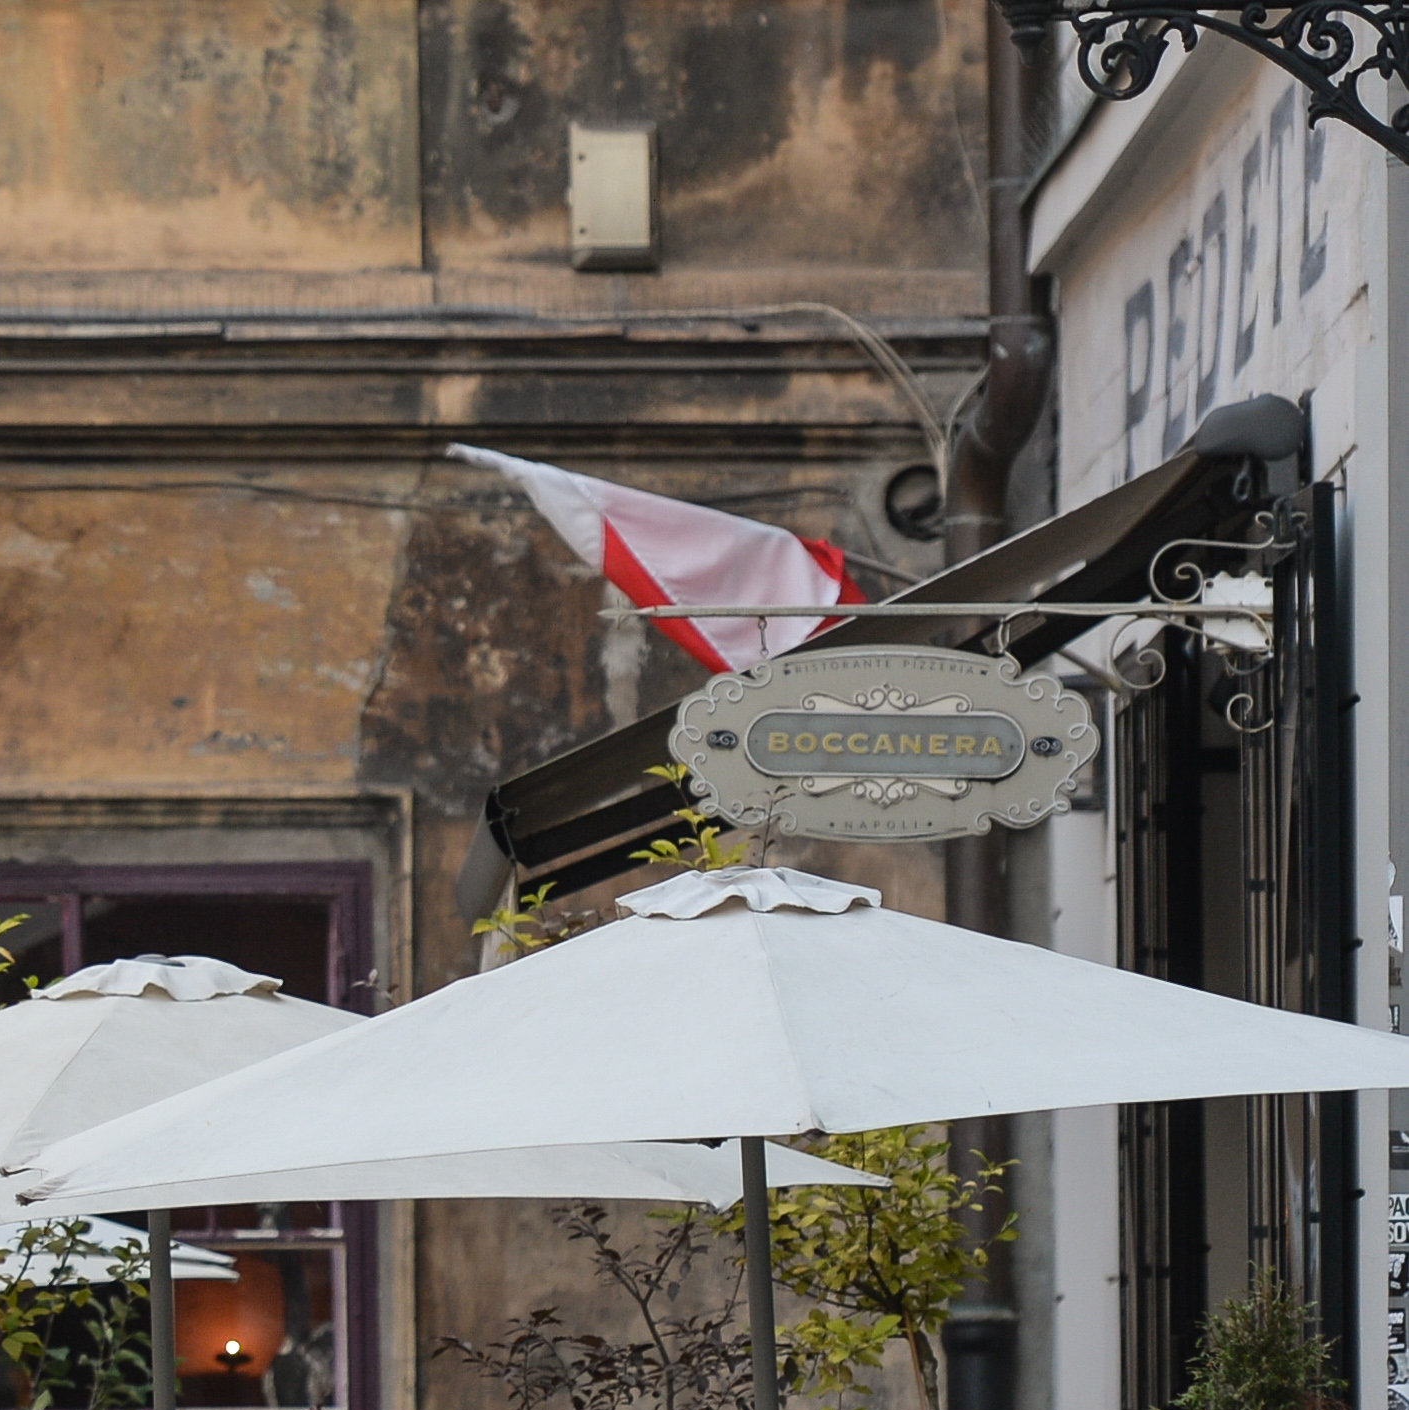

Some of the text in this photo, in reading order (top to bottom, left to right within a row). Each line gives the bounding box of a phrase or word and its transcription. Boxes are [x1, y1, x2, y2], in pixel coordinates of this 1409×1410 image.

[794, 659, 975, 675] RISTORANTE PIZZERIA
[767, 730, 1003, 757] BOCCANERA
[844, 819, 920, 831] NAPOLI
